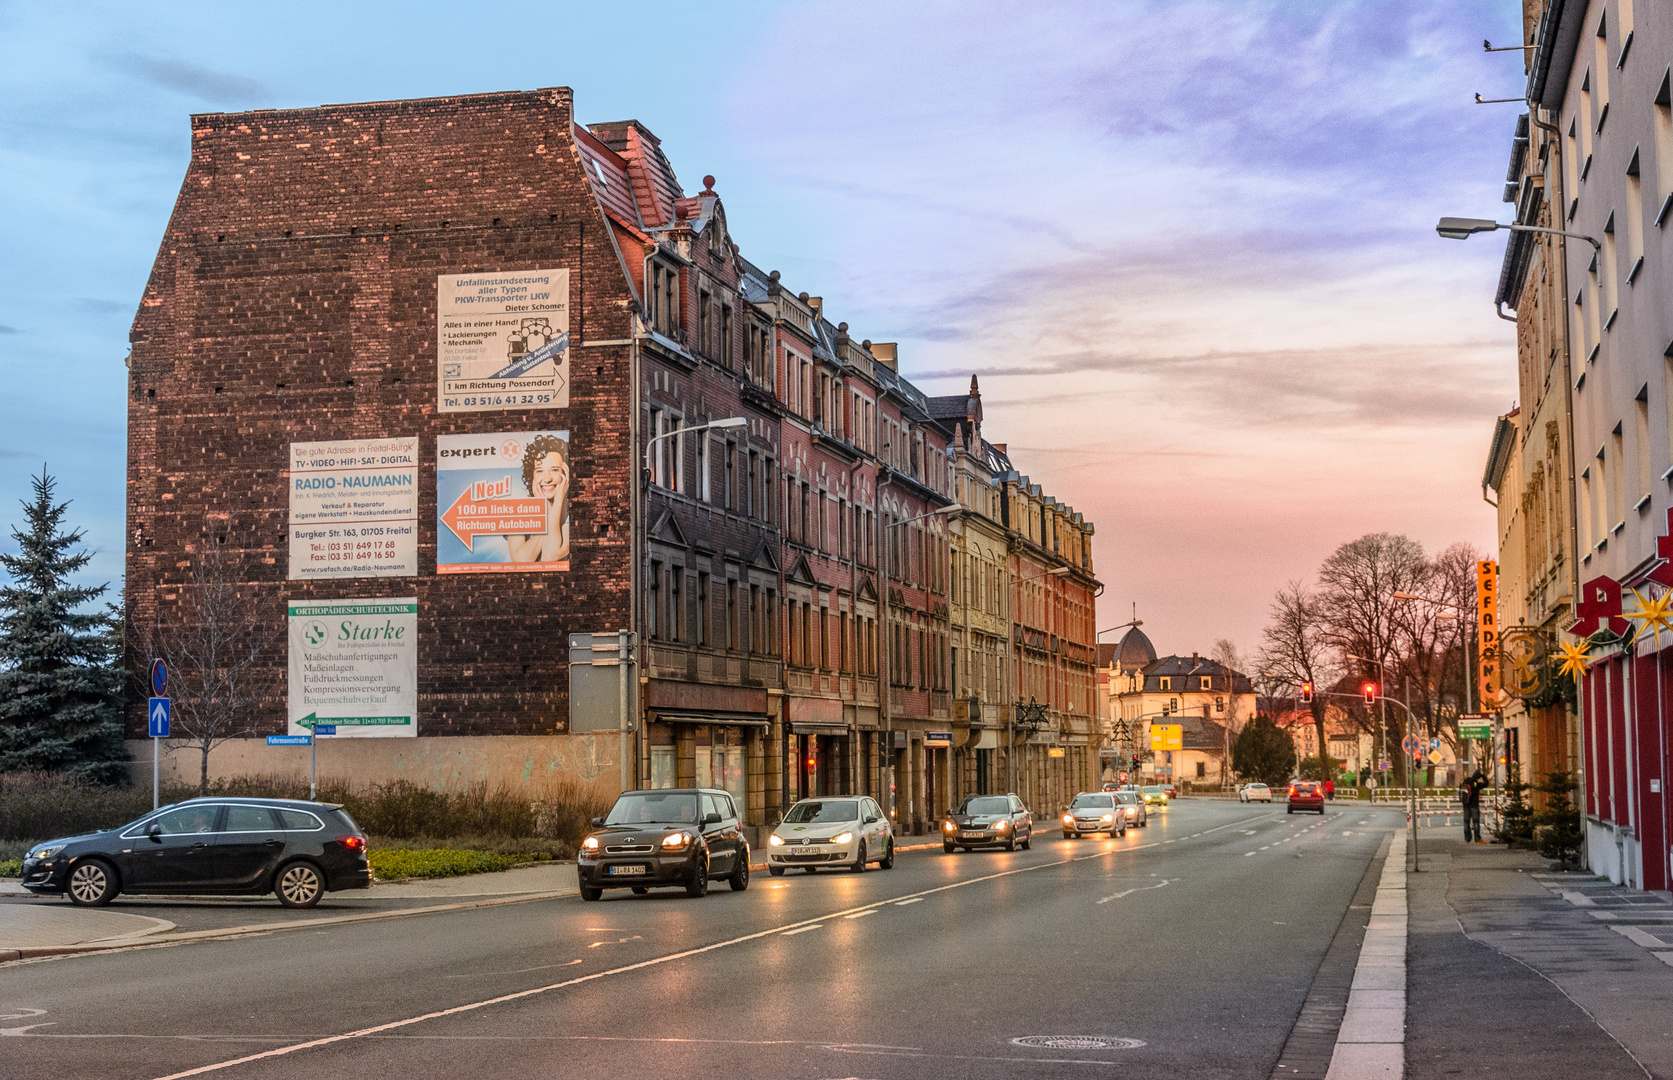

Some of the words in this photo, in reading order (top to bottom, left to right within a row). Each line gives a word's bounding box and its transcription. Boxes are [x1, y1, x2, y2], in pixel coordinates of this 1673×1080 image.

[456, 276, 549, 287] Unfallinstandsetzung
[478, 286, 497, 294] aller
[501, 286, 527, 295] Typen
[455, 294, 526, 304] PKW-Transporter
[448, 331, 497, 340] Lackierungen
[499, 357, 527, 378] Abholung
[534, 335, 568, 358] Anlieferung
[523, 351, 551, 371] kostenlos!
[470, 381, 506, 390] Richtung
[509, 379, 554, 388] Possendorf
[480, 396, 502, 405] 51/6
[537, 395, 550, 403] 95
[309, 448, 326, 457] gute
[328, 446, 356, 454] Adresse
[368, 443, 412, 453] Freital-Burgk
[440, 447, 496, 458] expert
[381, 456, 412, 464] DIGITAL
[476, 477, 509, 499] Neu!
[491, 504, 513, 514] links
[517, 504, 540, 513] dann
[457, 520, 496, 531] Richtung
[499, 520, 541, 529] Autobahn
[295, 530, 326, 540] Burgker
[343, 529, 358, 537] 163,
[387, 526, 411, 535] Freital
[328, 542, 340, 551] (03
[343, 542, 353, 551] 51)
[328, 553, 340, 561] (03
[343, 552, 353, 561] 51)
[296, 606, 409, 615] ORTHOPÄDIESCHUHTECHNIK
[338, 620, 405, 640] Starke
[304, 653, 398, 662] Maßschuhanfertigungen
[304, 664, 354, 673] Maßeinlagen
[304, 674, 383, 684] Fußdruckmessungen
[304, 685, 401, 695] Kompressionsversorgung
[304, 695, 387, 706] Bequemschuhverkauf
